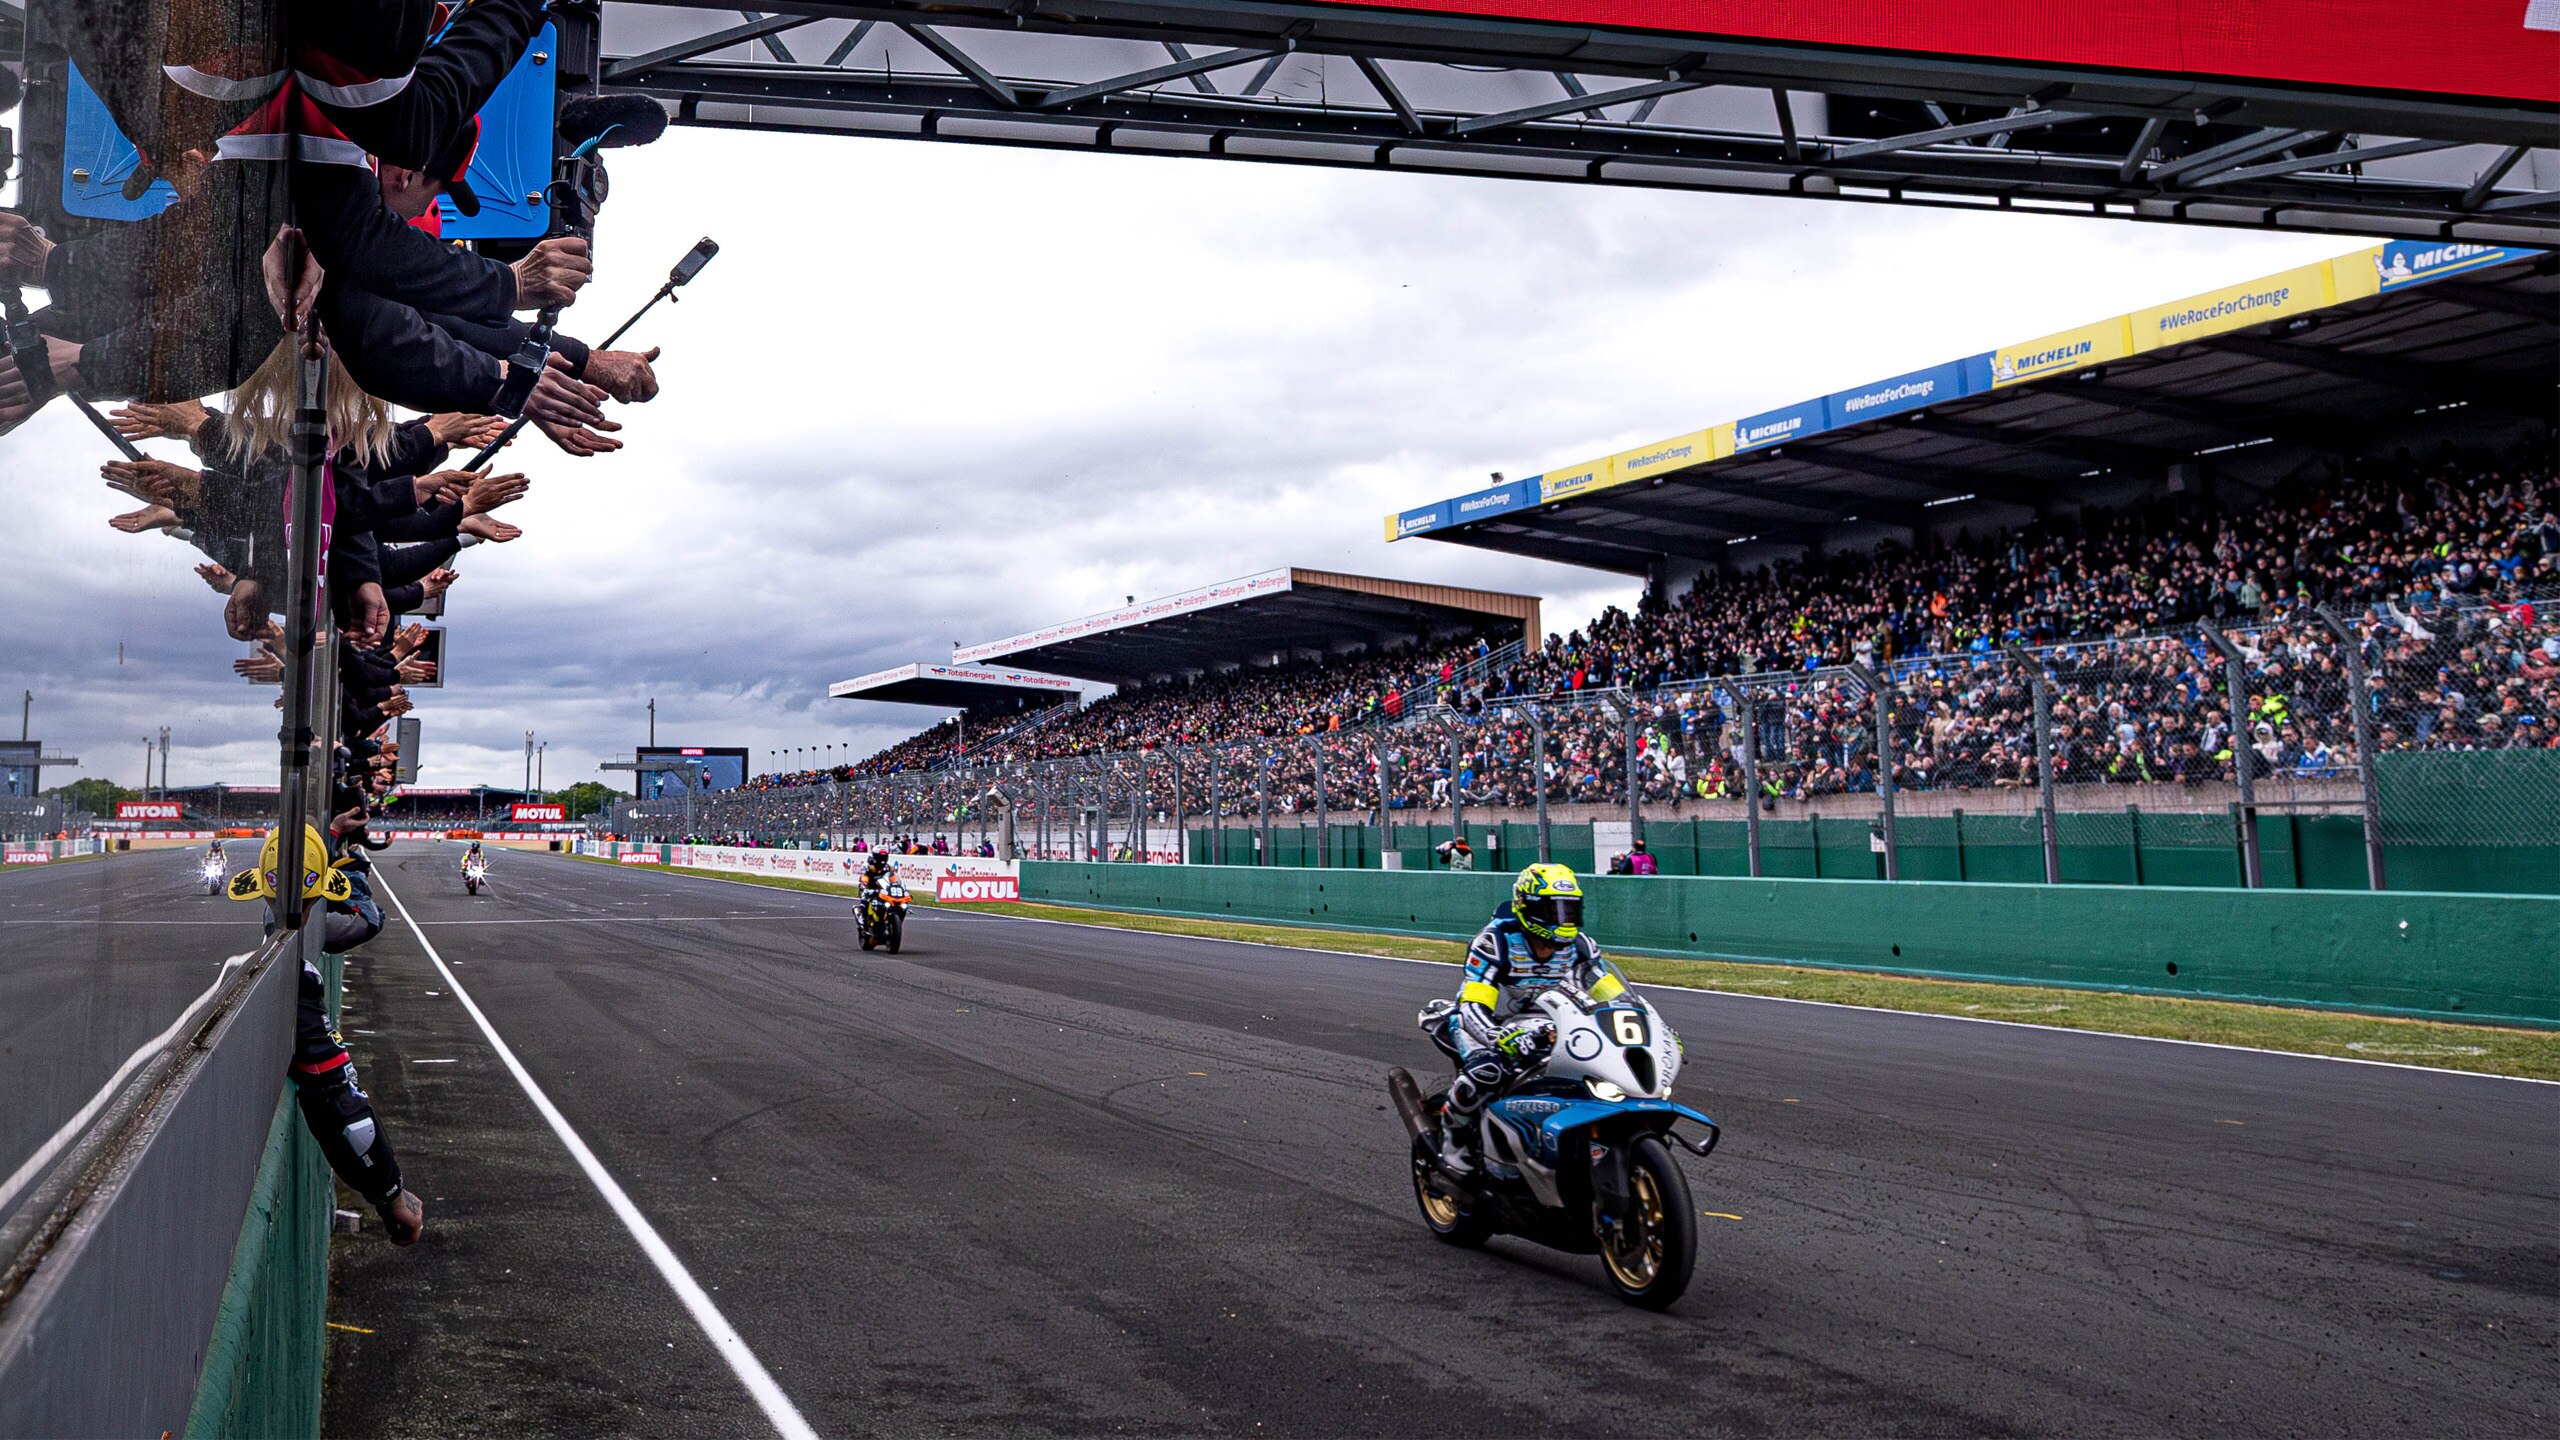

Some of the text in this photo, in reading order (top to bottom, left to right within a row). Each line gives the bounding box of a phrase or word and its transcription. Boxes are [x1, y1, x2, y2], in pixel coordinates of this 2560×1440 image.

[2413, 244, 2499, 270] MICHE
[2160, 287, 2290, 332] #WeRaceForChange
[2017, 341, 2092, 370] MICHELIN
[1845, 380, 1934, 413] #WeRaceForChange
[1750, 417, 1802, 441] MICHELIN
[1627, 446, 1692, 470] #WeRaceForChange
[1554, 473, 1594, 491] MICHELIN
[1406, 513, 1437, 530] MICHELIN
[947, 669, 996, 681] TotalEnergies
[1022, 675, 1071, 687] TotalEnergies
[515, 807, 562, 820] MOTUL
[621, 853, 660, 863] MOTUL
[940, 880, 1019, 899] MOTUL
[1613, 1010, 1643, 1045] 6
